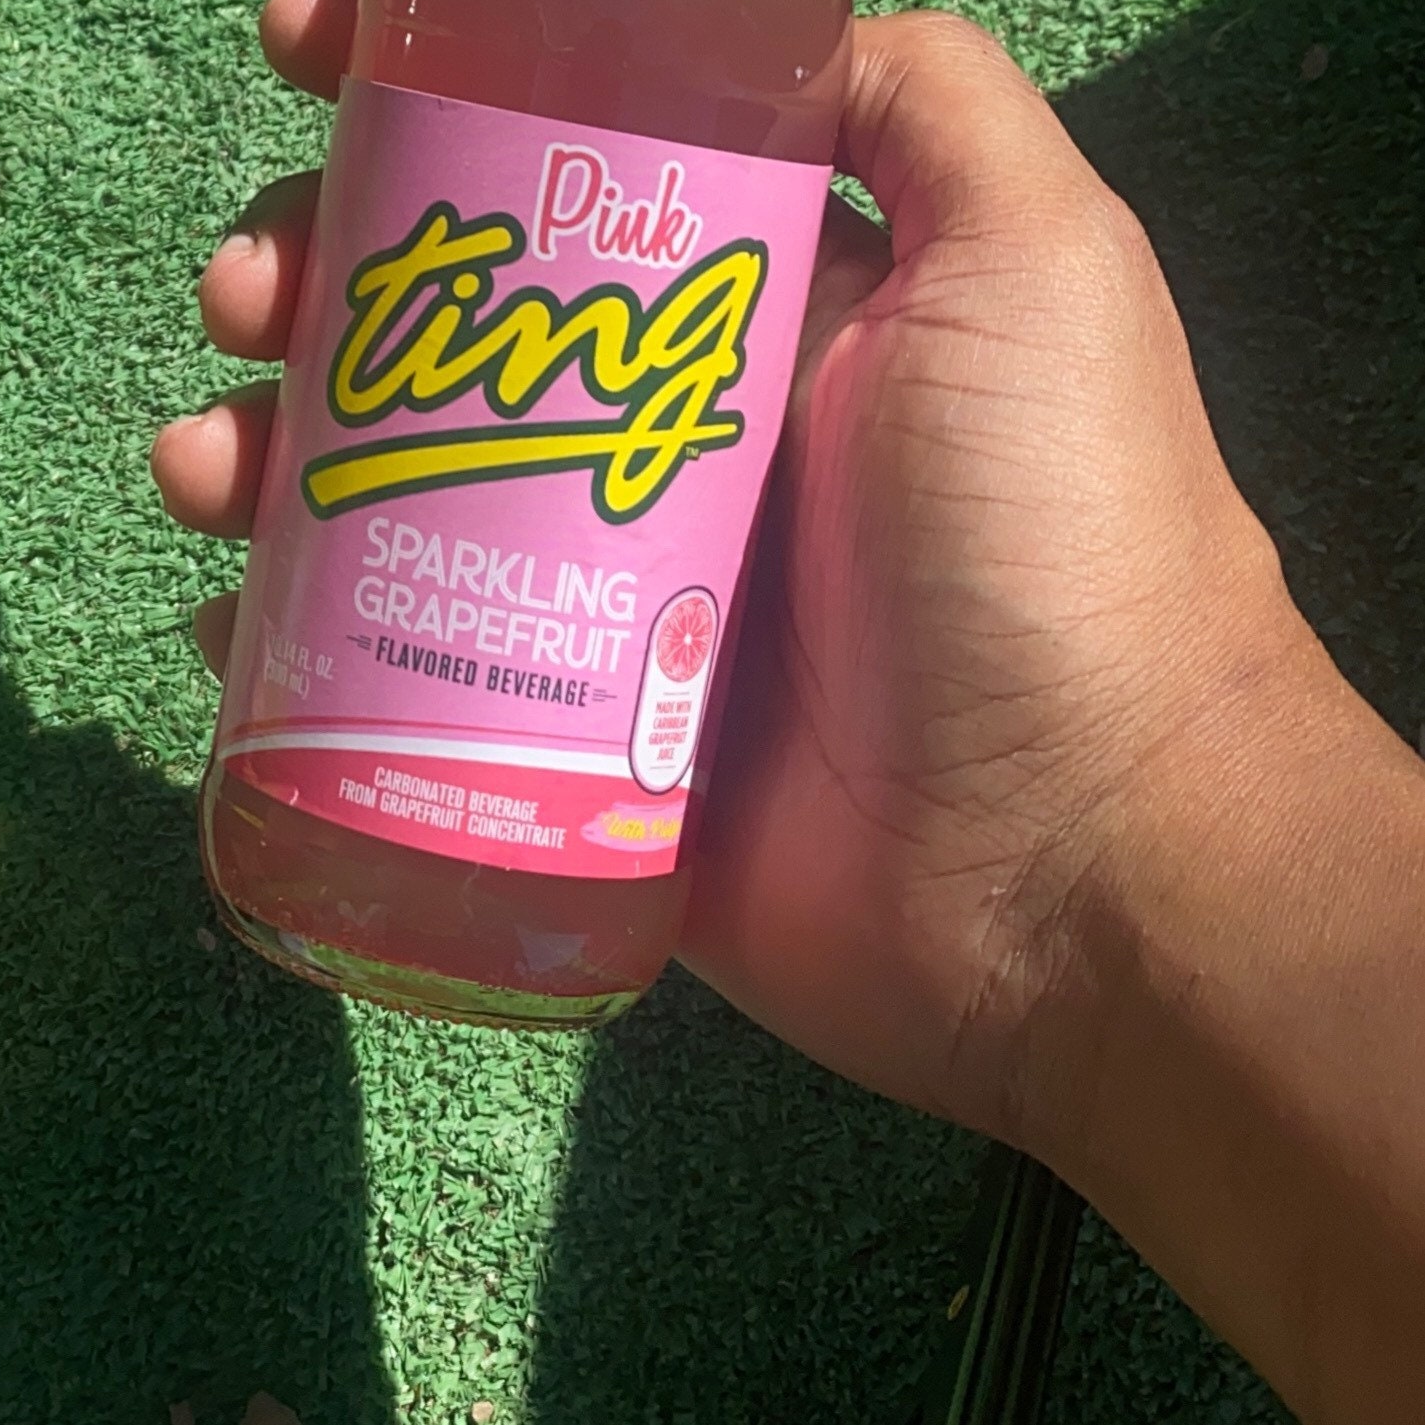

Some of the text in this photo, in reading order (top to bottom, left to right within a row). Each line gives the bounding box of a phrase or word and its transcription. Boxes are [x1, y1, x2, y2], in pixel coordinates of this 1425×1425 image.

[533, 143, 703, 268] Pink
[328, 201, 768, 523] ting
[362, 516, 638, 624] SPARKLING
[354, 575, 631, 673] GRAPEFRUIT
[376, 636, 590, 707] FLAVORED BEVERAGE
[339, 777, 568, 849] FROM GRAPEFRUIT CONCENTRATE
[374, 766, 539, 823] CARBONATED BEVERAGE
